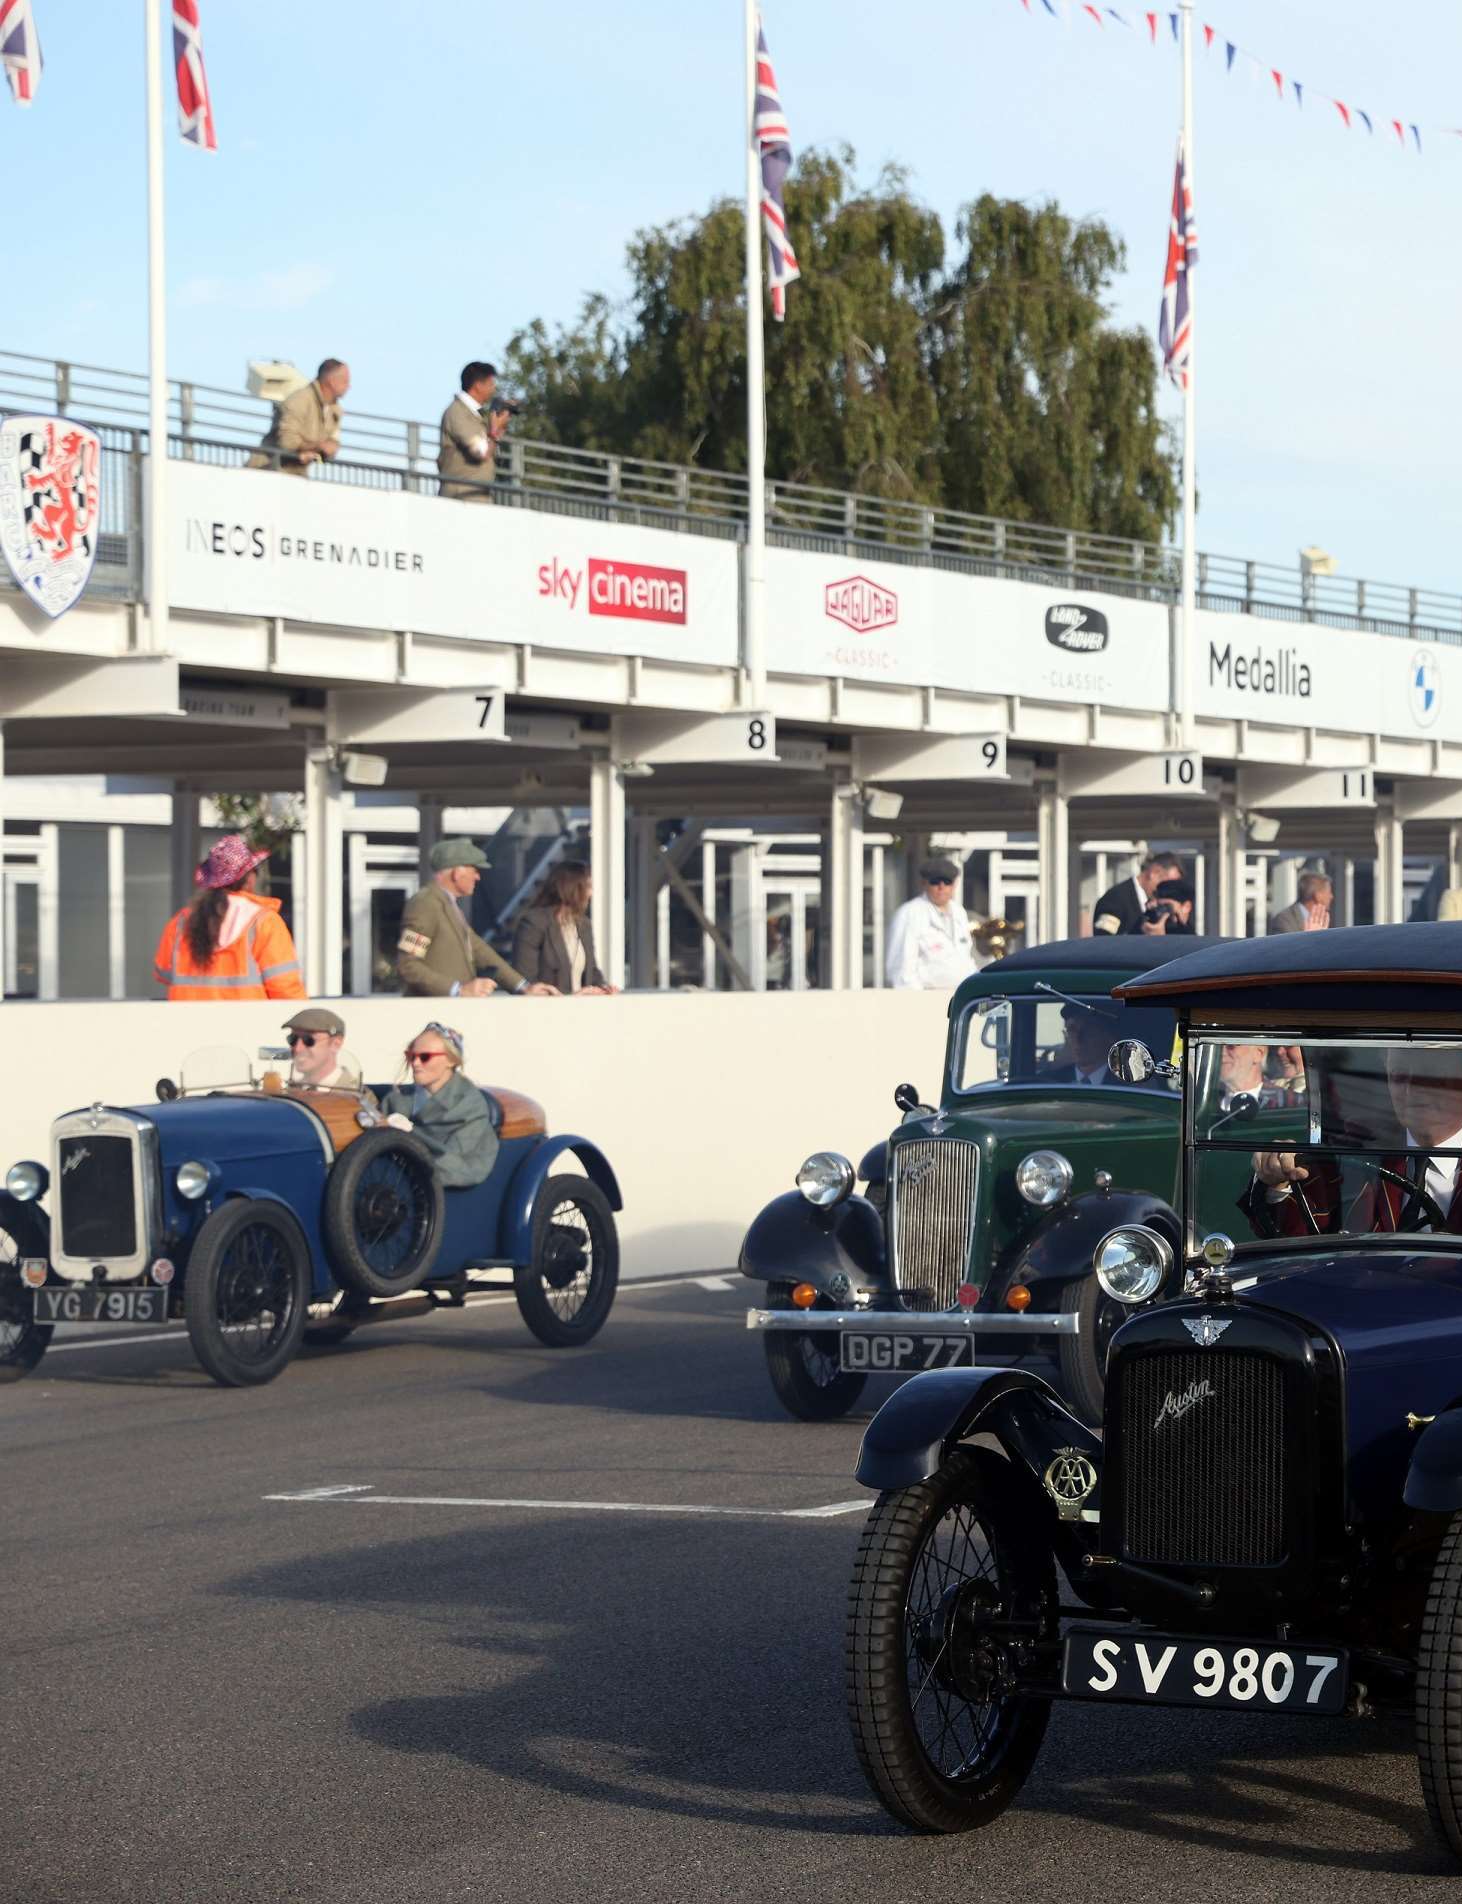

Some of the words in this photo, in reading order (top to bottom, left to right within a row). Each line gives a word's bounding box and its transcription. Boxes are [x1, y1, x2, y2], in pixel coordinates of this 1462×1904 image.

[186, 518, 266, 558] INEOS
[280, 537, 424, 573] GRENADIER
[538, 556, 583, 610] sky
[591, 564, 684, 613] cinema
[830, 584, 894, 624] JAGUAR
[1209, 641, 1311, 698] Medallia
[475, 696, 494, 728] 7
[749, 720, 765, 749] 8
[982, 742, 998, 768] 9
[1165, 759, 1194, 785] 10
[1343, 774, 1365, 798] 11
[47, 1292, 81, 1319] YG
[93, 1291, 153, 1320] 7915
[850, 1336, 914, 1368] DGP
[922, 1337, 967, 1368] 77
[1153, 1378, 1216, 1429] Austin
[1192, 1647, 1338, 1704] 9807
